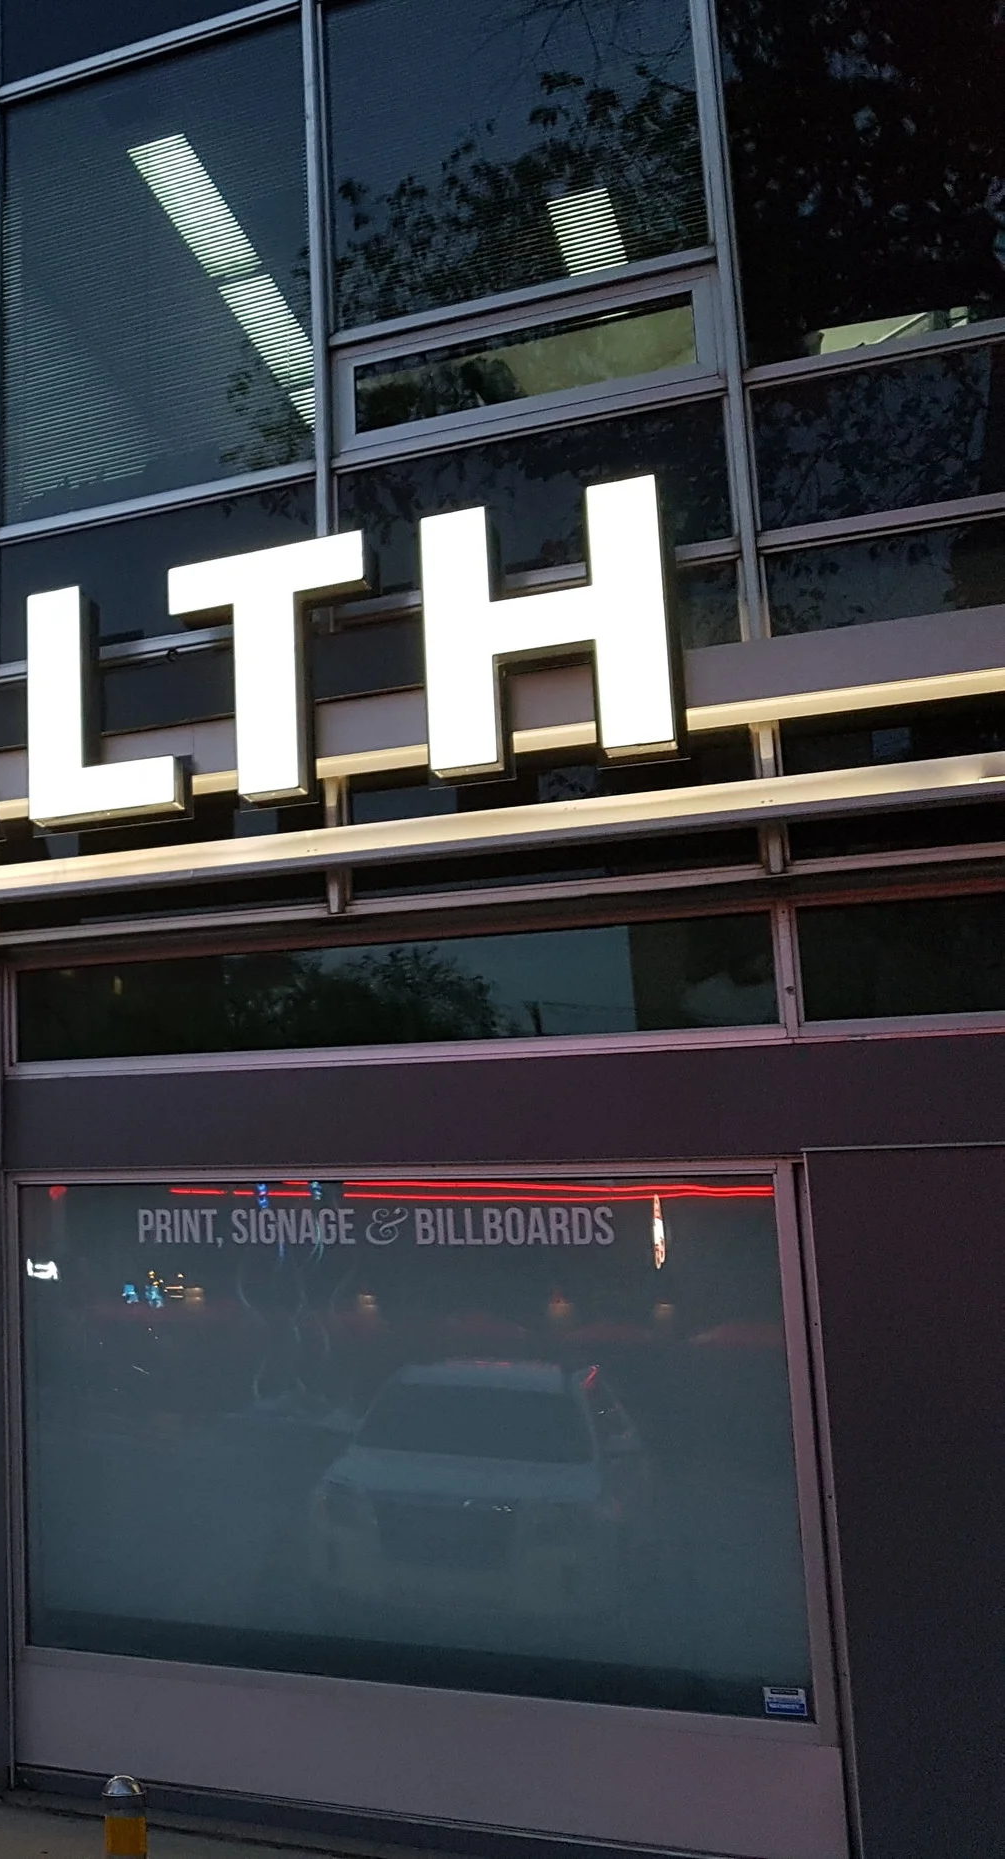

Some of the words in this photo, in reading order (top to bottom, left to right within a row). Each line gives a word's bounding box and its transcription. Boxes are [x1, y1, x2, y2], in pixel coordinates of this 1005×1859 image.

[137, 1207, 223, 1247] PRINT,
[231, 1207, 355, 1246] SIGNAGE
[366, 1207, 407, 1245] &
[415, 1206, 615, 1246] BILLBOARDS
